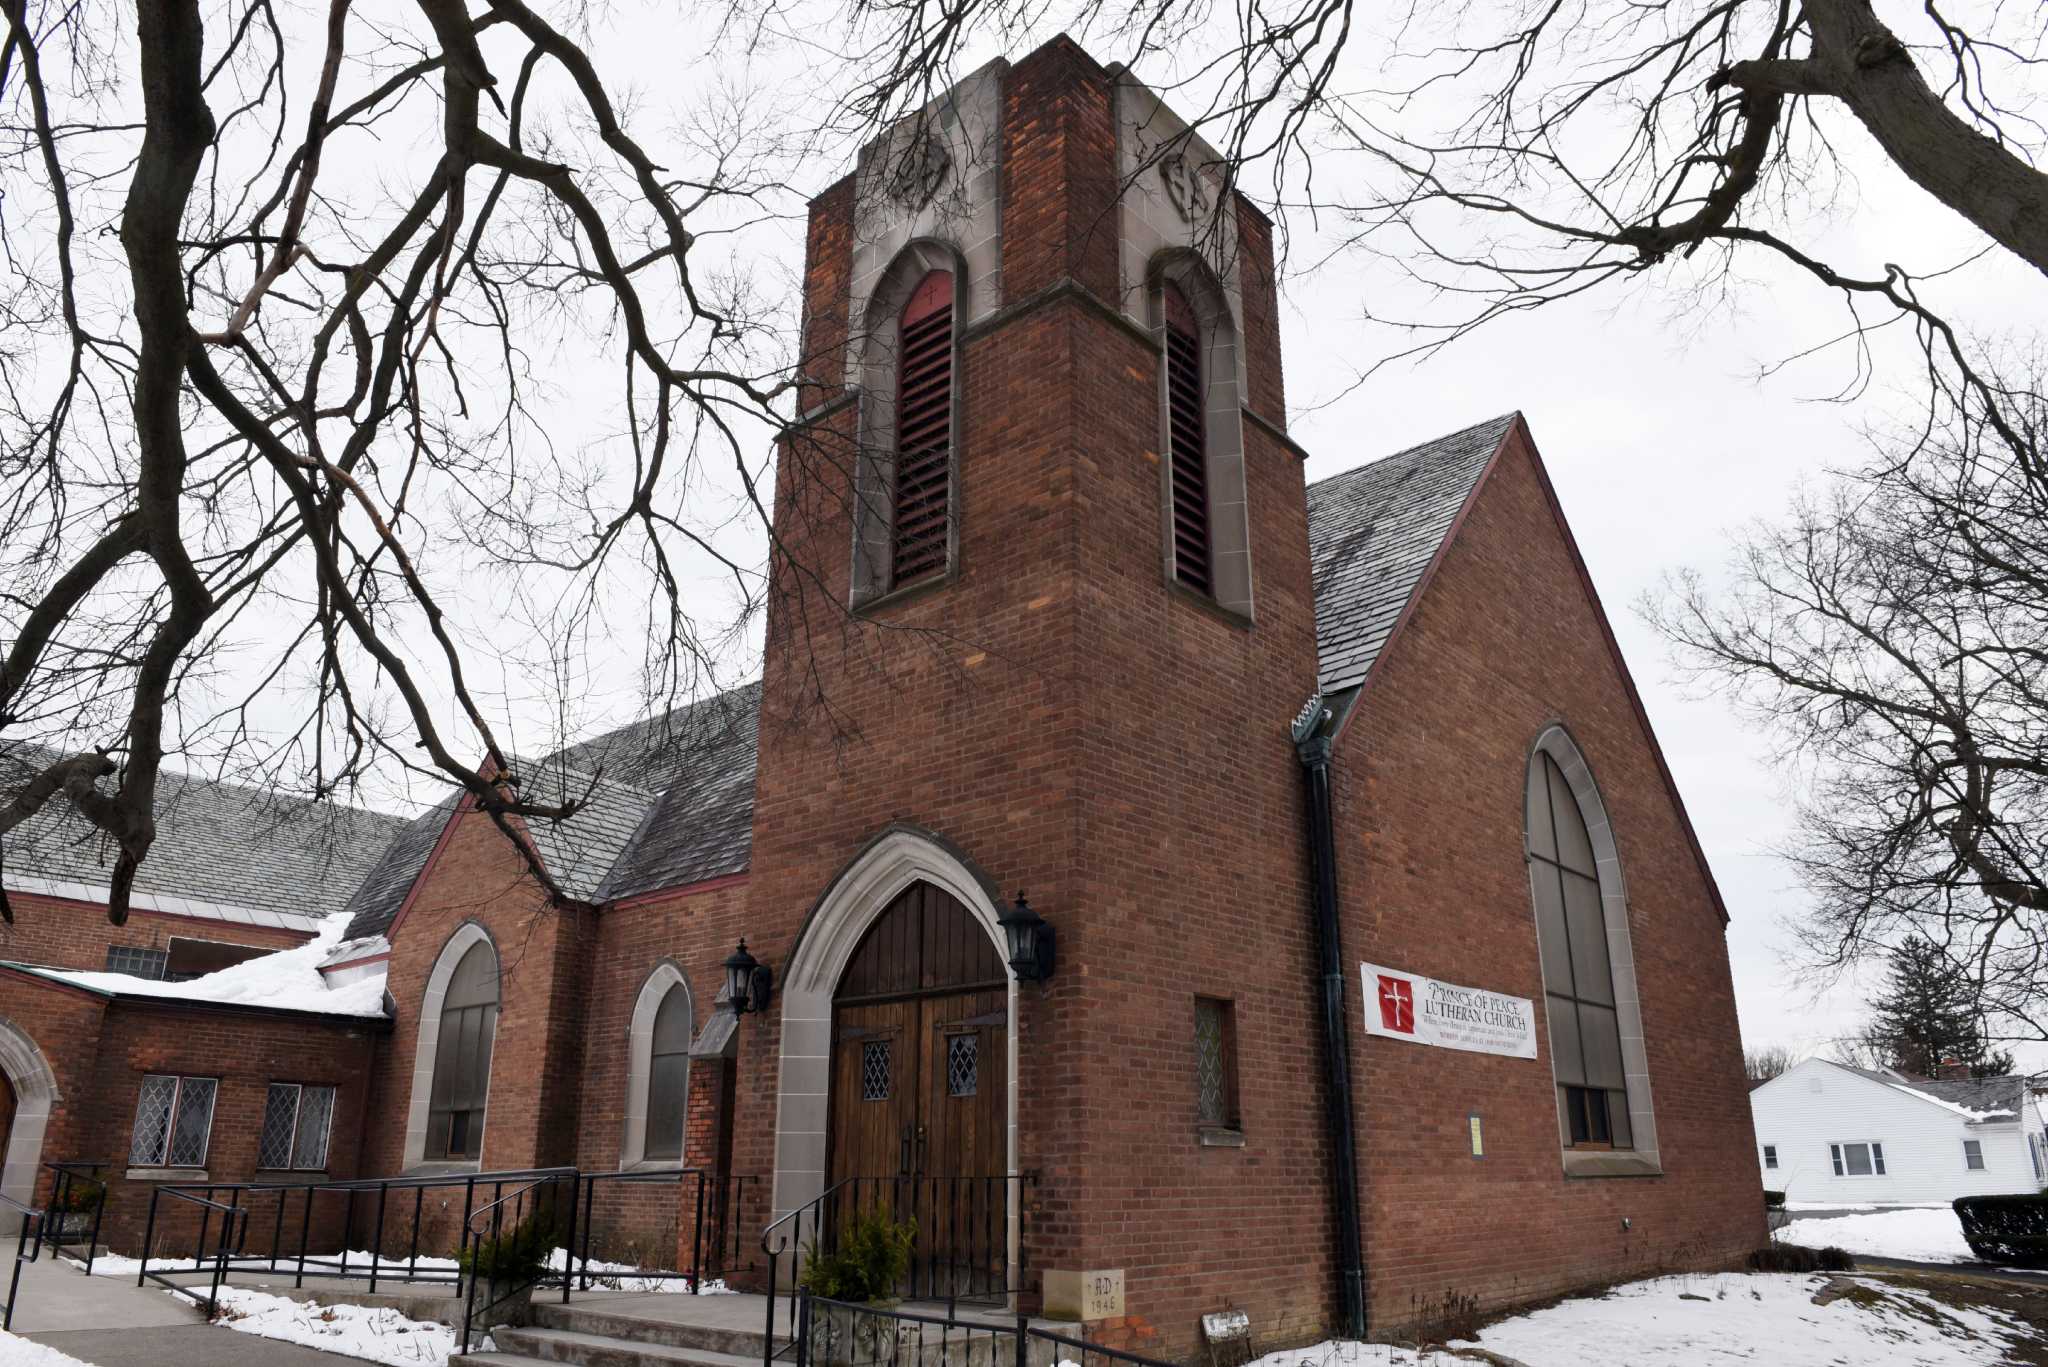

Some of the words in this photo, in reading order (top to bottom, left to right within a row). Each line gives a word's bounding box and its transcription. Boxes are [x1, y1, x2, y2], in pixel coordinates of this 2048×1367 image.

[1428, 982, 1472, 1007] PRINCE
[1474, 994, 1488, 1009] OF
[1490, 997, 1521, 1016] PEACE
[1425, 1000, 1482, 1023] LUTHERAN
[1484, 1010, 1526, 1031] CHURCH
